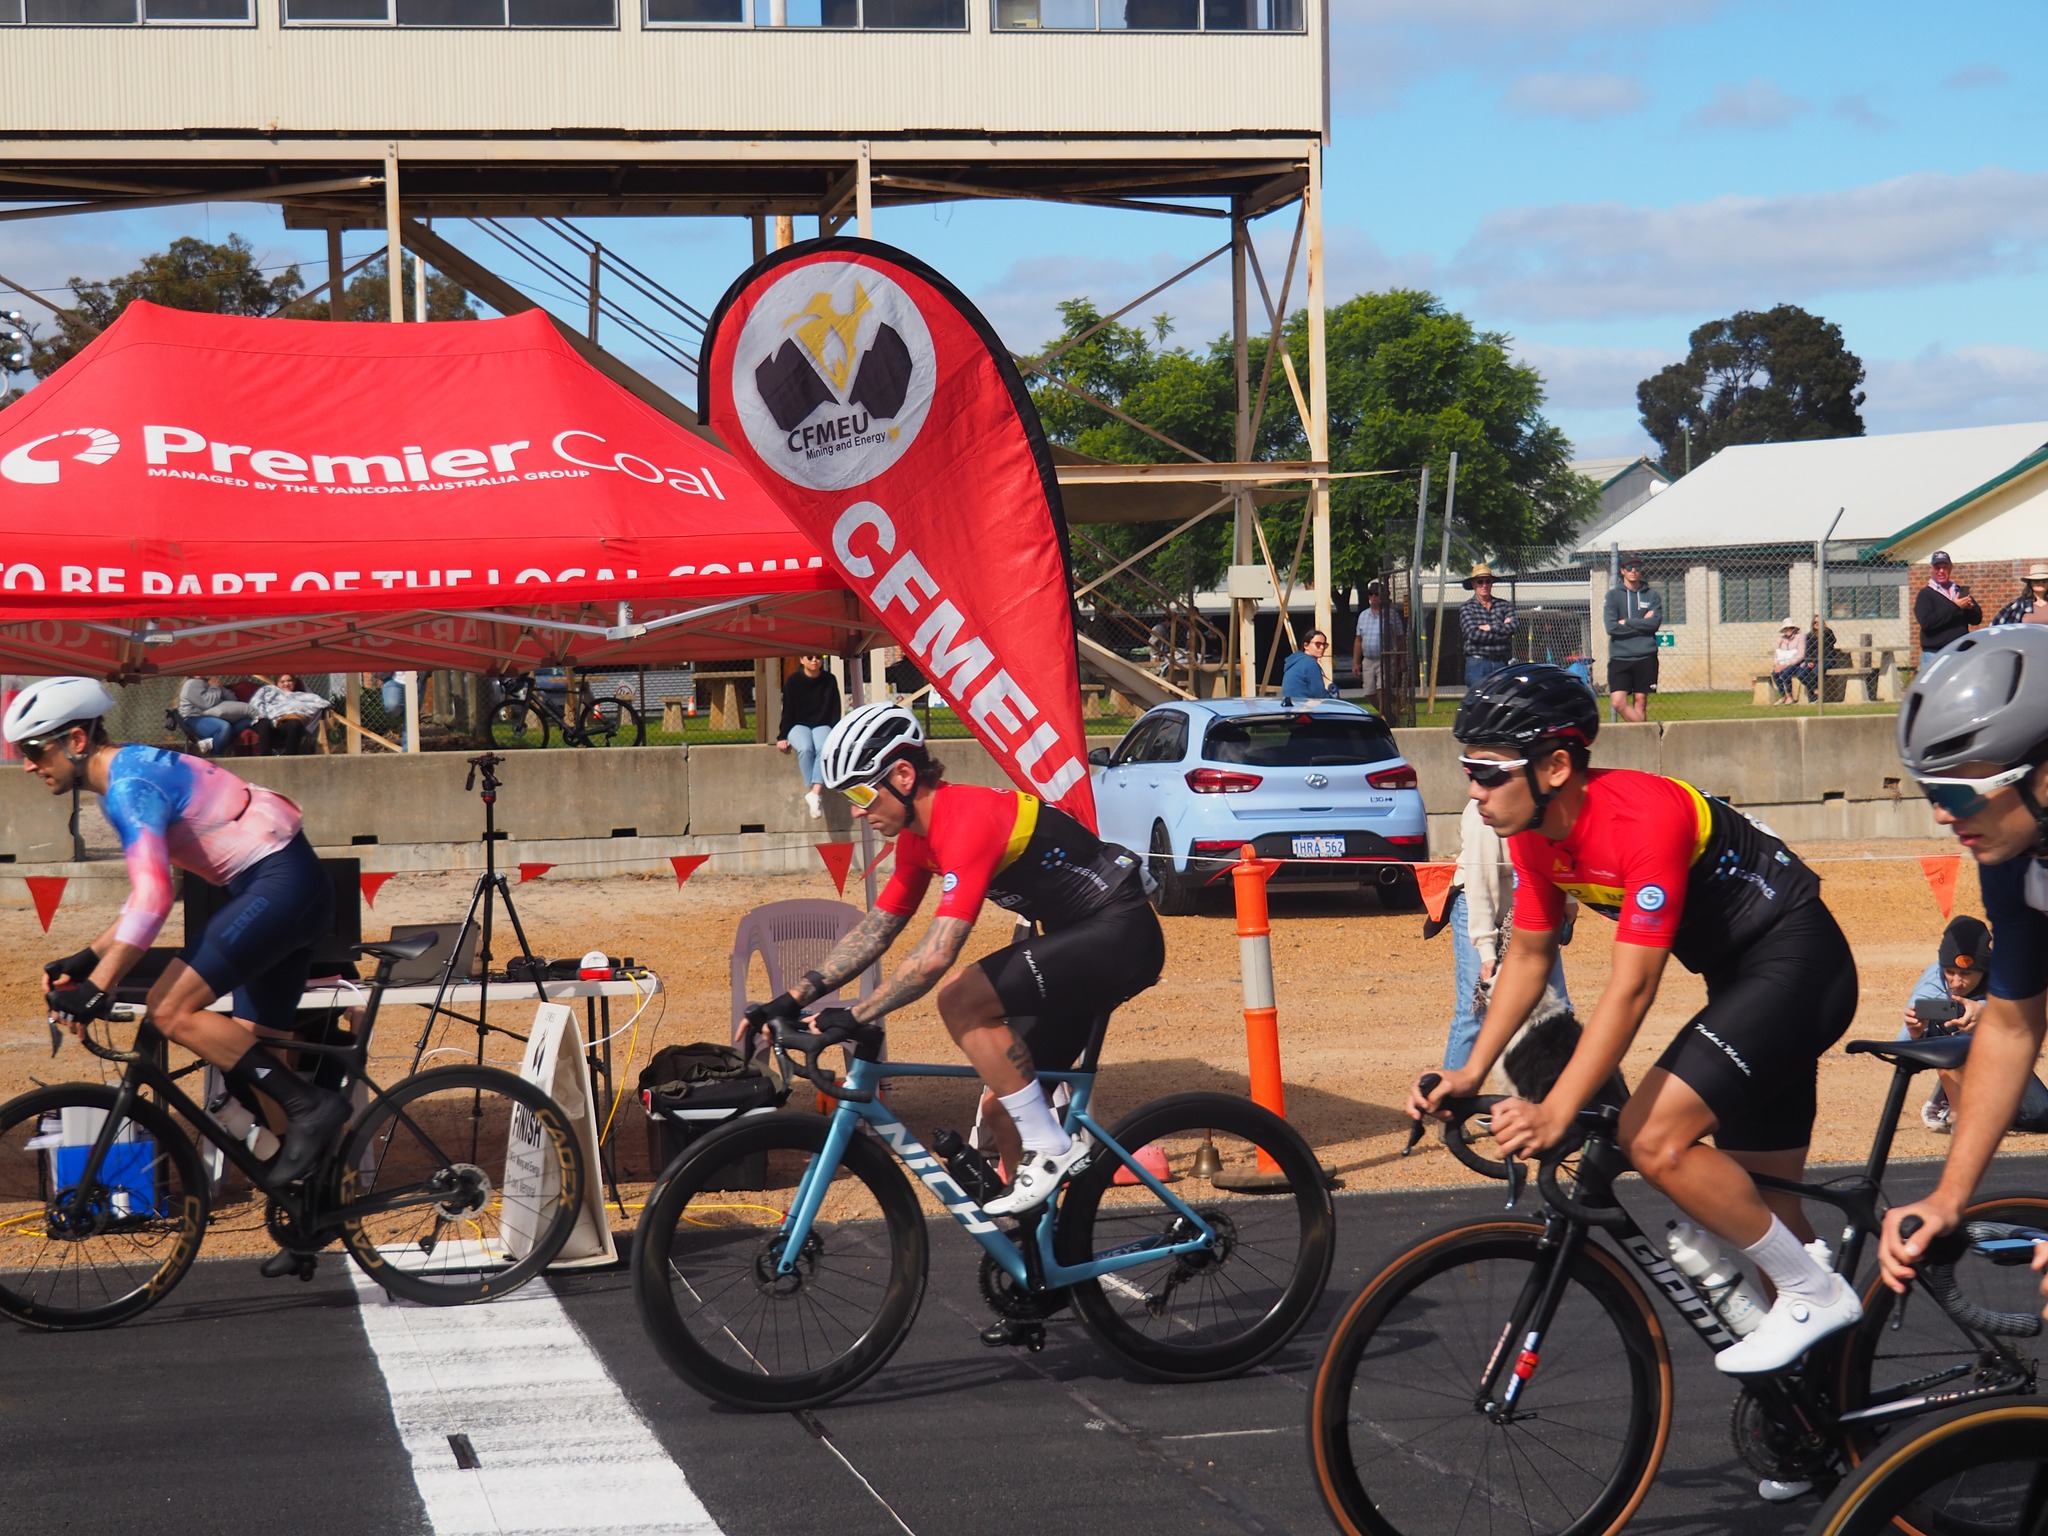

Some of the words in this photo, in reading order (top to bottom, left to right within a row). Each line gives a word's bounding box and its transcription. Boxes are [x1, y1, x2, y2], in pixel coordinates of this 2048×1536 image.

[787, 411, 870, 453] CFMEU
[806, 445, 834, 461] Mining
[835, 438, 853, 453] and
[854, 430, 887, 448] Energy
[143, 425, 530, 484] Premier
[552, 430, 726, 501] Coal
[147, 468, 249, 488] MANAGED
[254, 481, 278, 491] BY
[285, 483, 320, 494] THE
[324, 482, 412, 494] YANCOAL
[417, 474, 520, 492] AUSTRALIA
[524, 469, 590, 482] GROUP
[832, 501, 1087, 802] CFMEU
[1295, 841, 1320, 854] 1HRA
[1325, 841, 1343, 853] 562
[512, 1103, 542, 1149] FINISH
[535, 1108, 577, 1211] CADEX
[148, 1196, 201, 1301] CADEX
